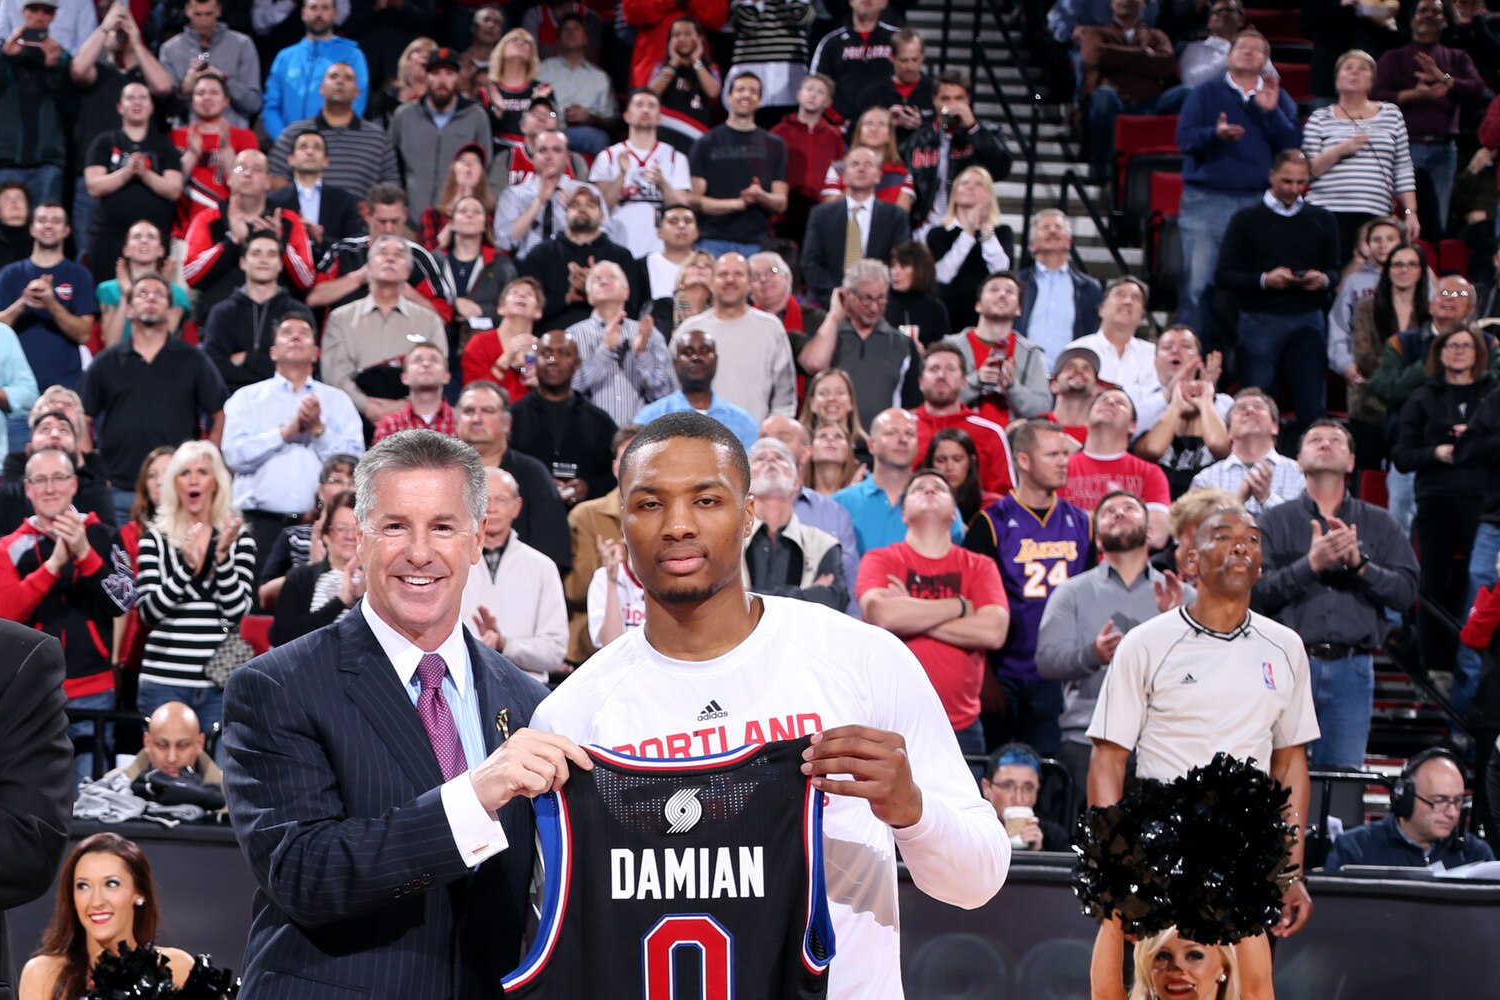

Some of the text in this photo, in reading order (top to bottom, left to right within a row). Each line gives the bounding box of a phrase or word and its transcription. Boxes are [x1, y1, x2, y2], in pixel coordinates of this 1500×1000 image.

[1023, 560, 1068, 598] 24
[697, 710, 729, 722] adidas
[610, 846, 765, 900] DAMIAN
